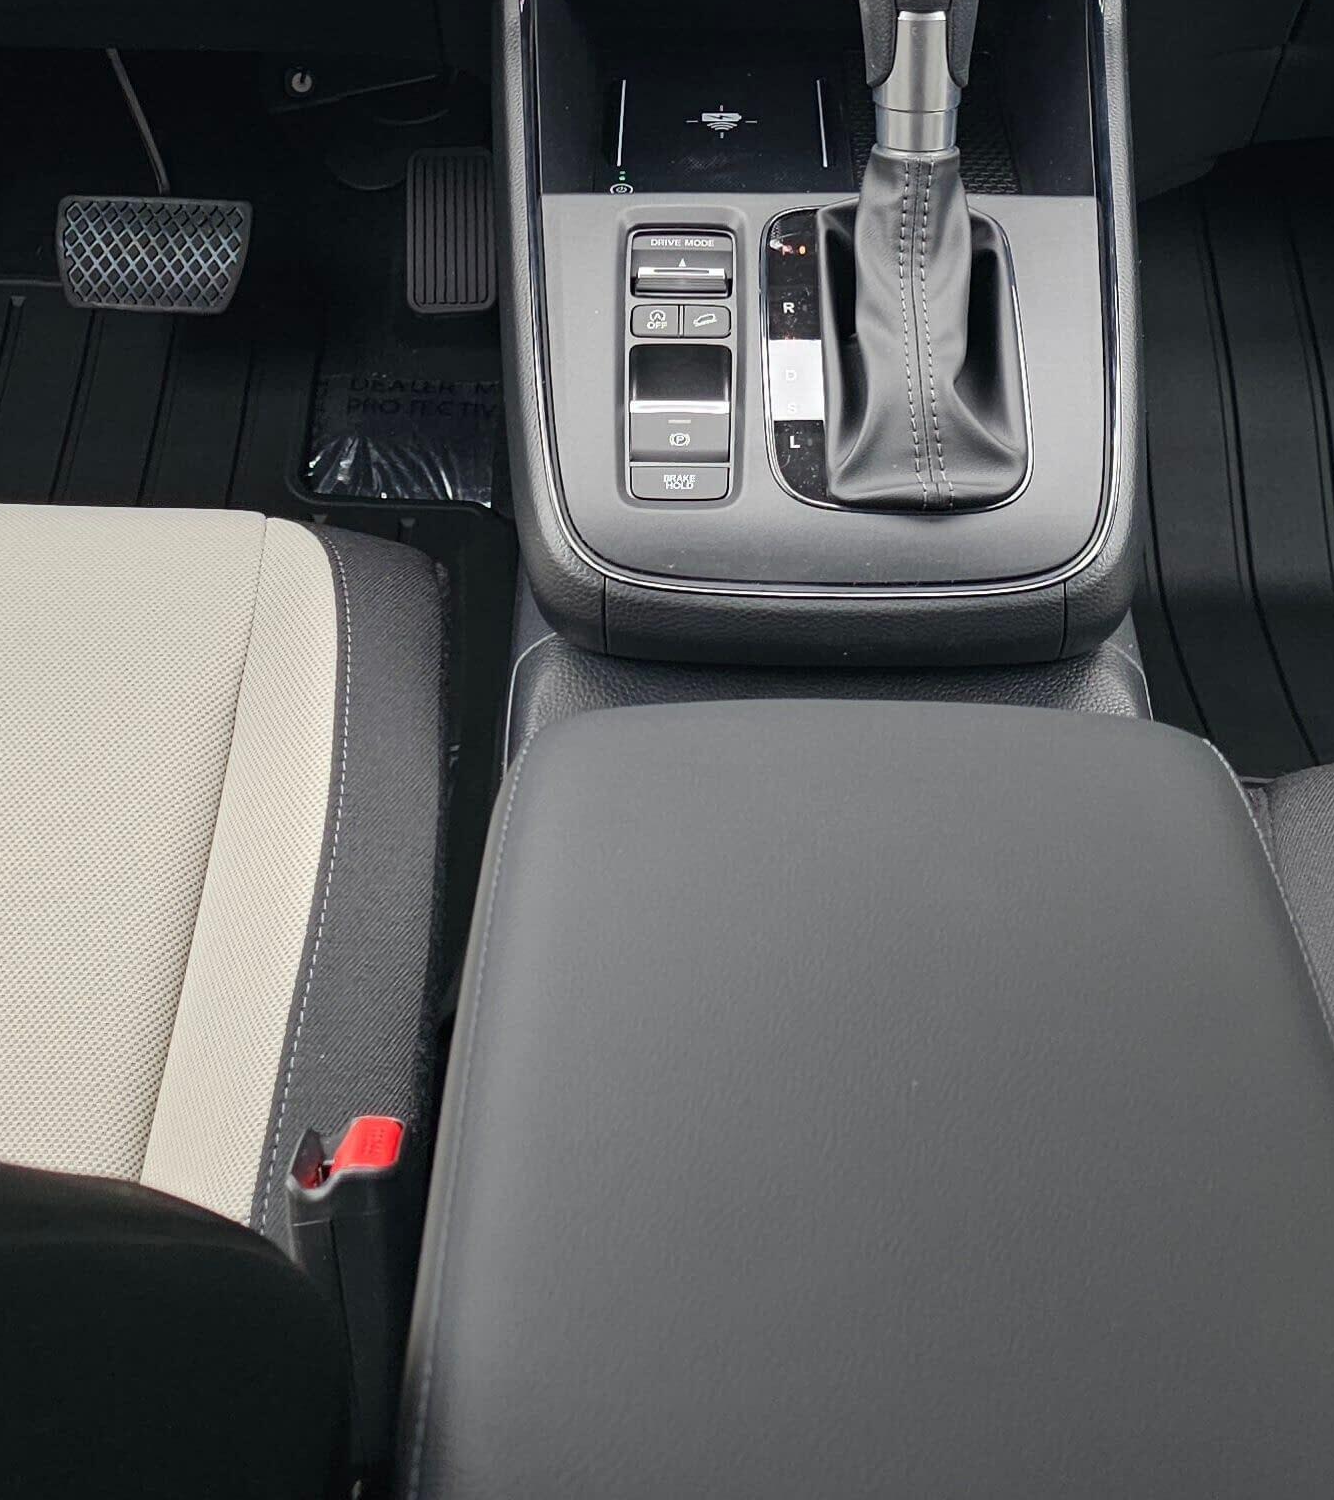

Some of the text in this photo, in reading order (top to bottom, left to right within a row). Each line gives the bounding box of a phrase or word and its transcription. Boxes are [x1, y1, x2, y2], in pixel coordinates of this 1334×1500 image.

[650, 238, 715, 248] DRIVE MODE
[782, 302, 795, 314] R
[646, 321, 668, 330] OFF
[785, 369, 797, 381] D
[789, 435, 801, 449] L
[663, 474, 697, 482] BRAKE
[665, 482, 694, 490] HOLD
